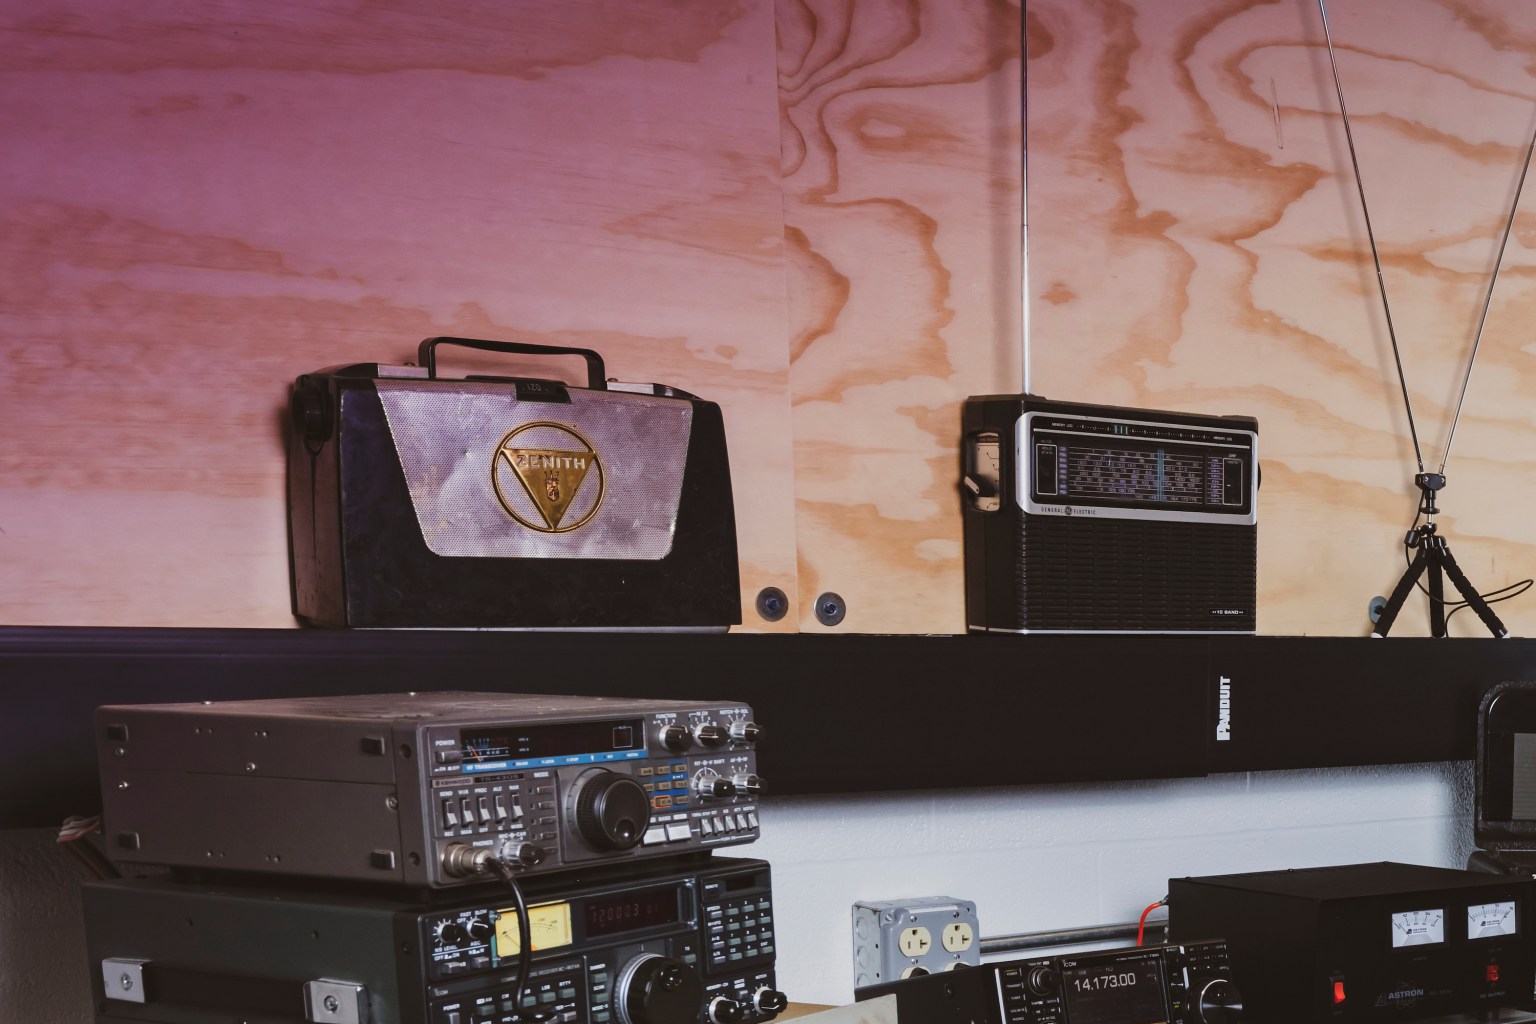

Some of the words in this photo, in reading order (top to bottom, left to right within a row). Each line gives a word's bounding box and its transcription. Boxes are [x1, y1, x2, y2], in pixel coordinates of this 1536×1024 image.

[517, 454, 586, 470] ZENITH
[1041, 506, 1064, 514] GENERAL
[1073, 508, 1097, 516] ELECTRIC
[1217, 676, 1231, 741] PANDUIT
[440, 777, 472, 786] KENWOOD
[472, 839, 494, 847] PHONES
[460, 910, 472, 918] FAST
[474, 908, 488, 916] SLOW
[444, 944, 459, 952] LEVEL
[1074, 972, 1136, 992] 14.173.00
[1388, 988, 1425, 1000] ASTRON
[443, 1003, 461, 1011] POWER
